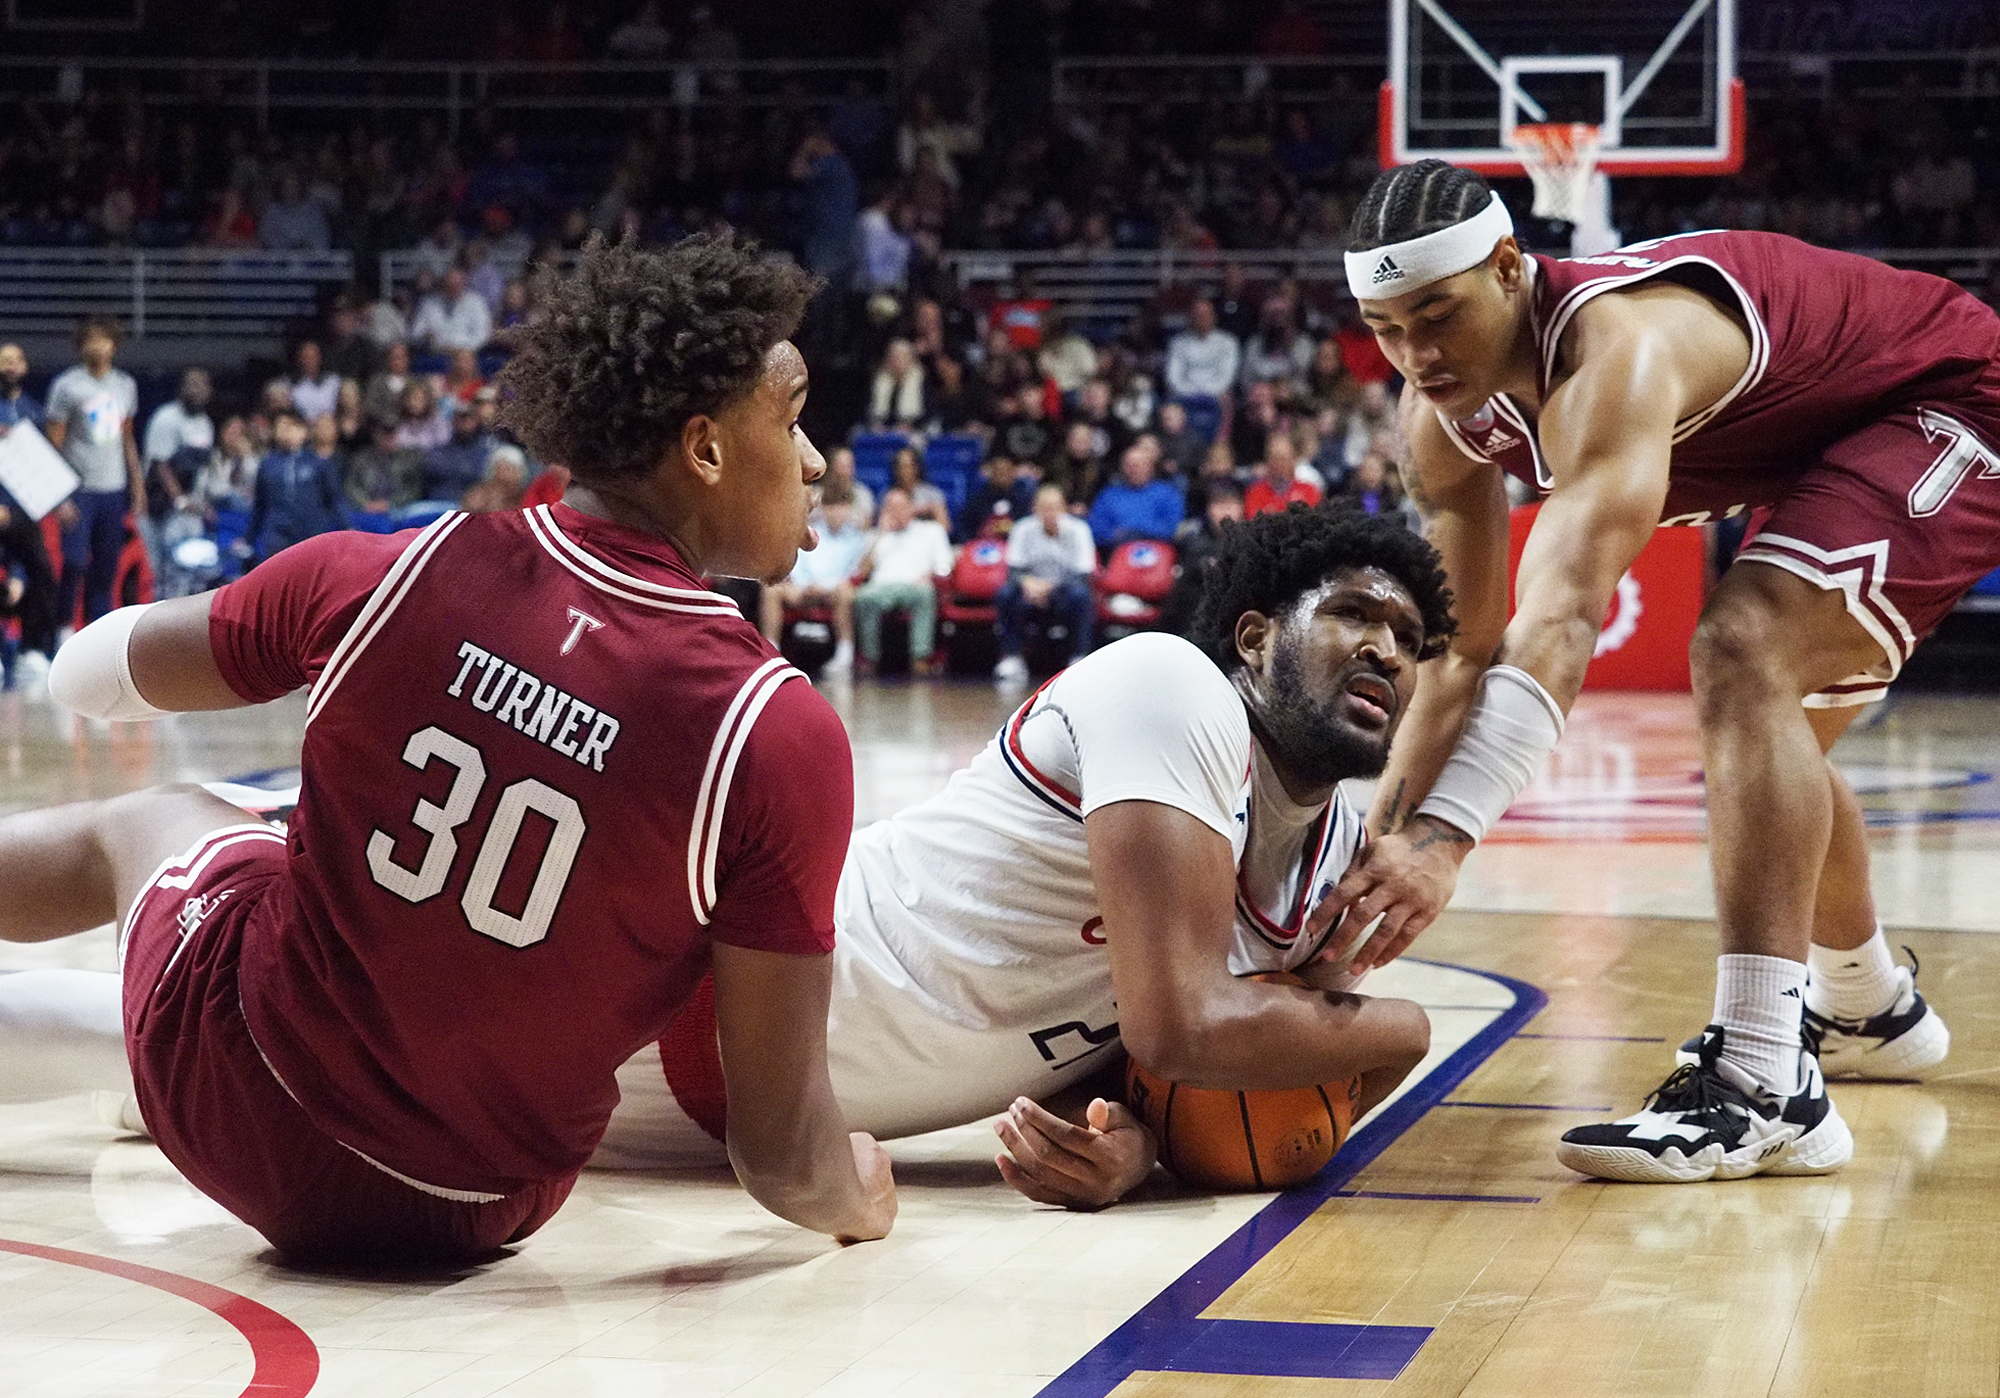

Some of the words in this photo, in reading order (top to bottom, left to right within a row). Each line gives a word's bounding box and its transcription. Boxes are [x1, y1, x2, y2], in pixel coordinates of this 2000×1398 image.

[1372, 270, 1405, 283] adidas
[1483, 438, 1521, 456] adidas
[560, 605, 606, 656] T
[446, 639, 621, 773] TURNER
[365, 724, 587, 949] 30
